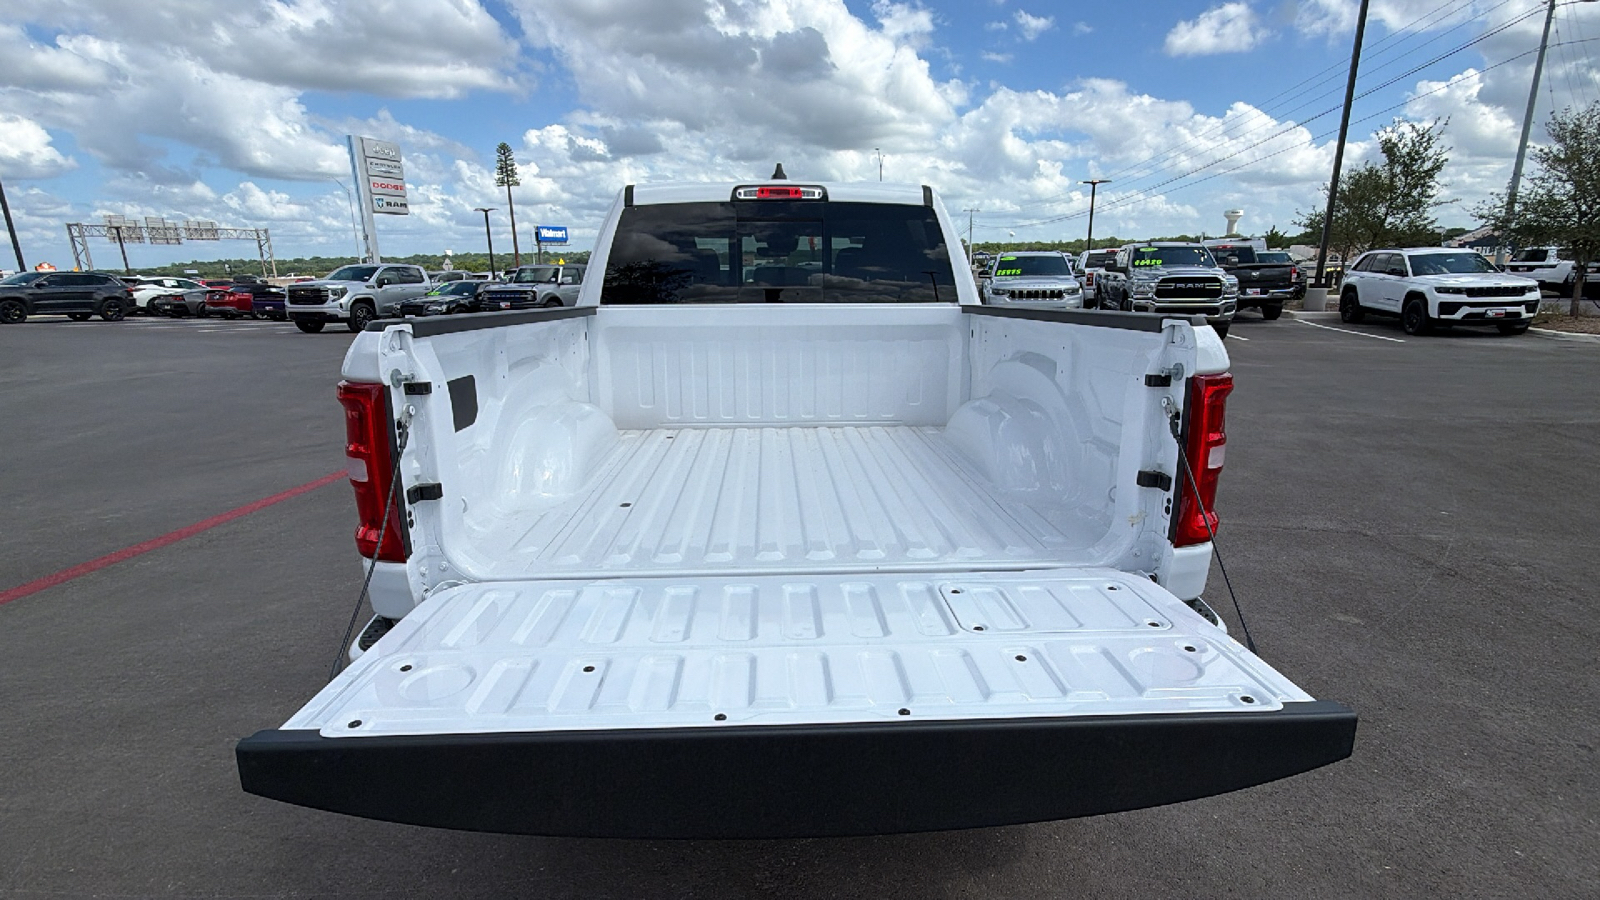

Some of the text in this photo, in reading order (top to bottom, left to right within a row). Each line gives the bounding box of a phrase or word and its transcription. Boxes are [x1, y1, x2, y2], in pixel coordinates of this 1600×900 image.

[373, 182, 405, 191] DODGE
[386, 201, 408, 209] RAM
[540, 228, 566, 238] Walmart
